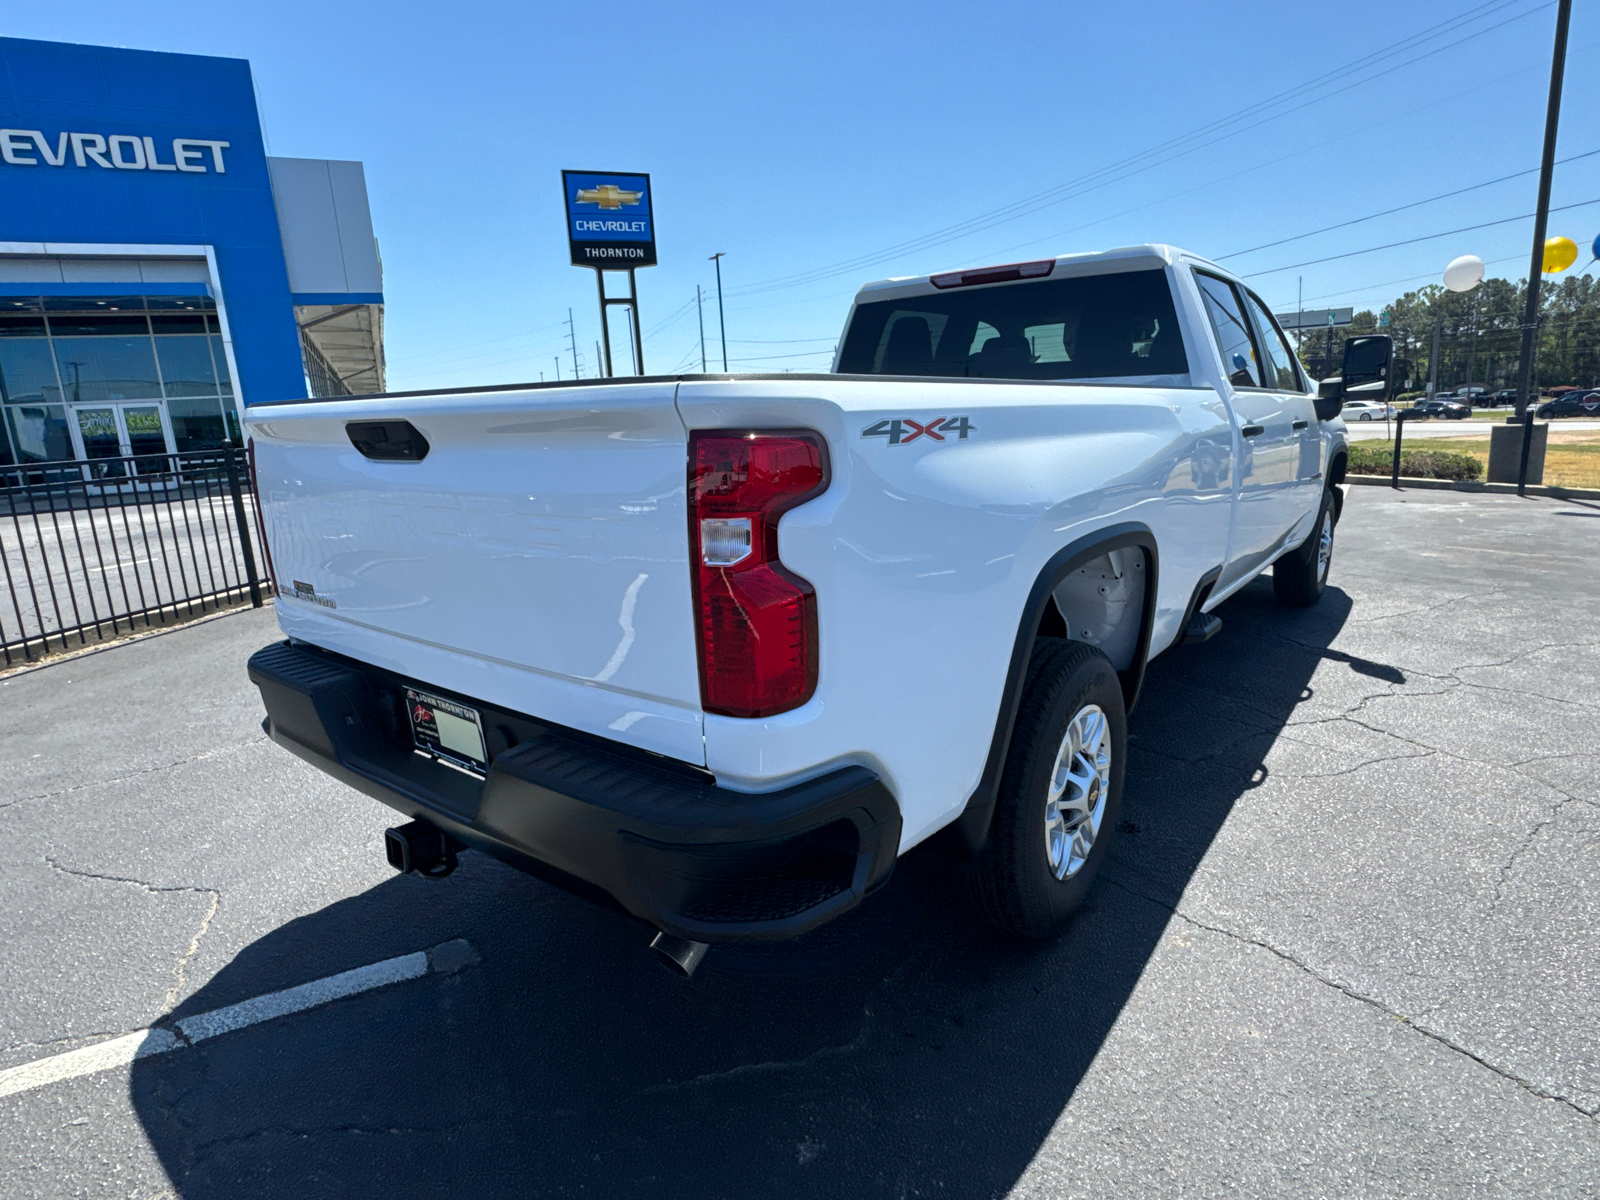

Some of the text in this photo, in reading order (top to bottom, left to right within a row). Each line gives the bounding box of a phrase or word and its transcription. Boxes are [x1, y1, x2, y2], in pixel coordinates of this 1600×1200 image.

[576, 220, 646, 232] CHEVROLET
[584, 247, 644, 258] THORNTON
[419, 694, 475, 720] JOHN THORNTON
